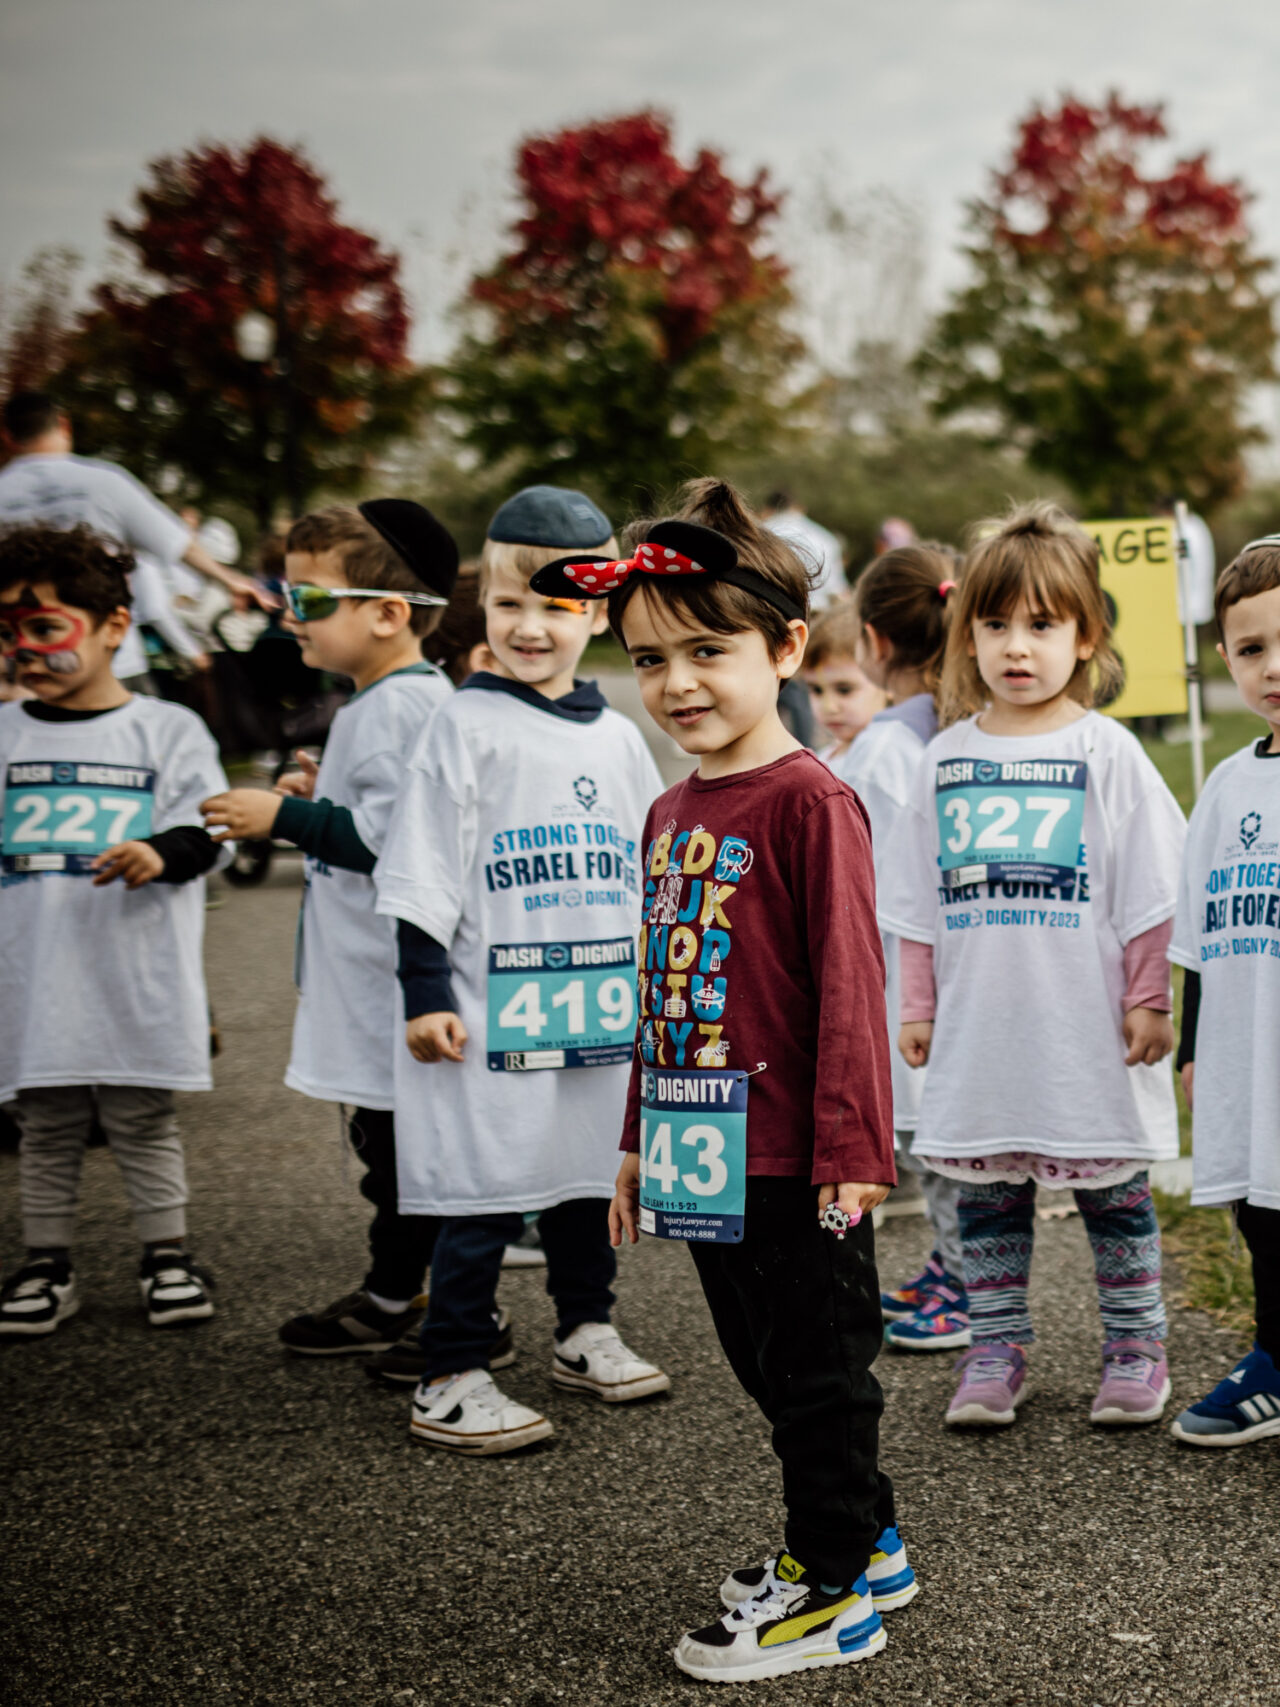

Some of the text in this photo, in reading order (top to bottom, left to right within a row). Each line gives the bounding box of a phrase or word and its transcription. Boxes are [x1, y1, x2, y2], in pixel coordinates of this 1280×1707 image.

[937, 762, 1077, 786] DASH DIGNITY
[11, 794, 141, 844] 227
[944, 796, 1071, 854] 327
[493, 824, 578, 855] STRONG
[485, 852, 578, 893] ISRAEL
[523, 892, 560, 912] DASH
[946, 909, 1080, 931] DASH DIGNITY 2023
[495, 942, 632, 969] DASH DIGNITY
[499, 976, 634, 1037] 419
[658, 1077, 734, 1103] DIGNITY
[663, 1215, 723, 1227] InjuryLawyer.com
